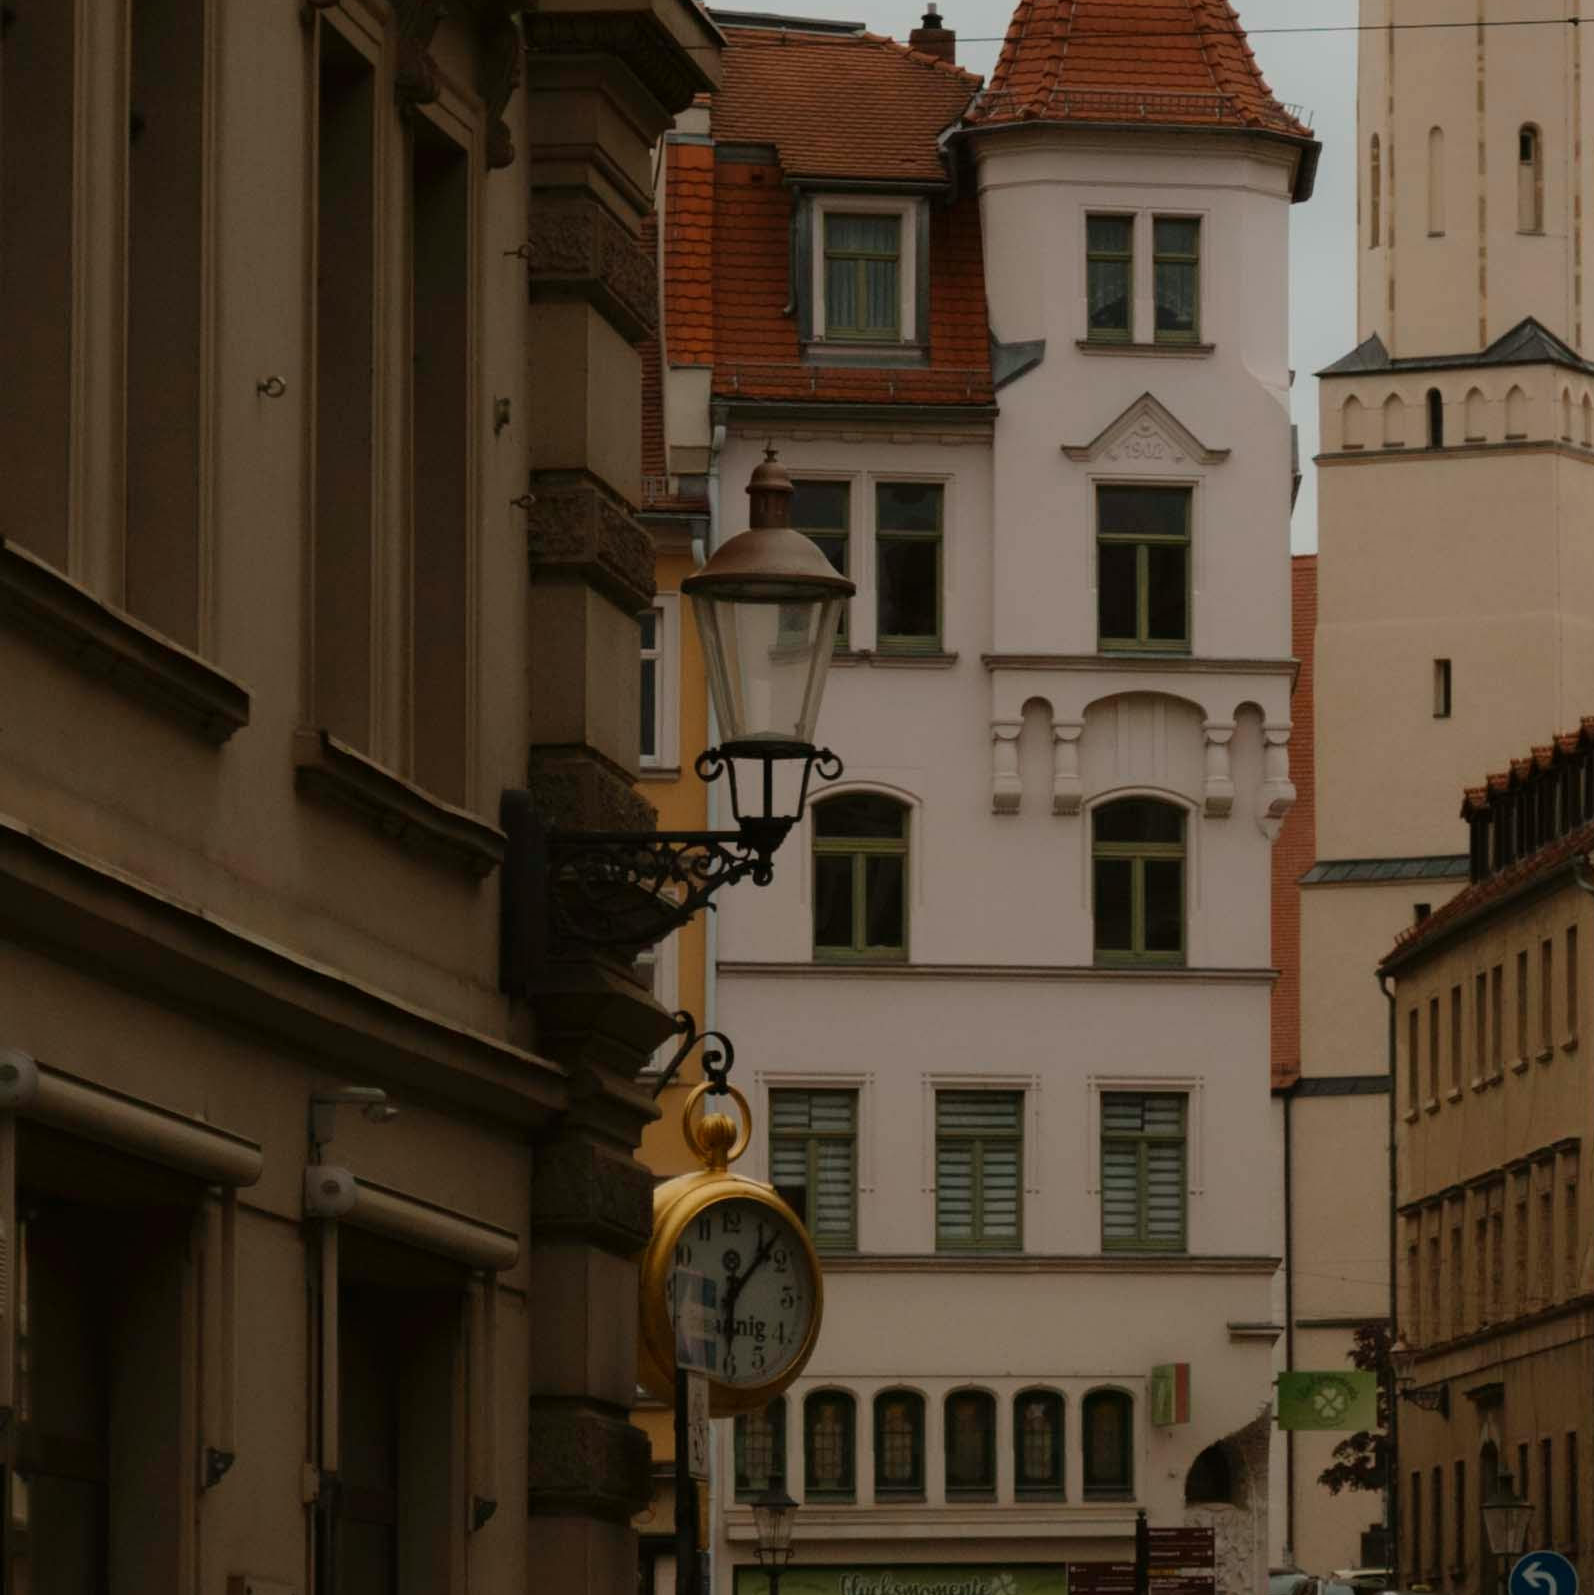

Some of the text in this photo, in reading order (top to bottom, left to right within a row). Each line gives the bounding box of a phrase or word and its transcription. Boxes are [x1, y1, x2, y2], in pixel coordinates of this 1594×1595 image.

[697, 1218, 712, 1241] 11
[722, 1211, 741, 1234] 12
[773, 1249, 788, 1272] 2
[780, 1287, 794, 1309] 3
[751, 1346, 766, 1370] 5
